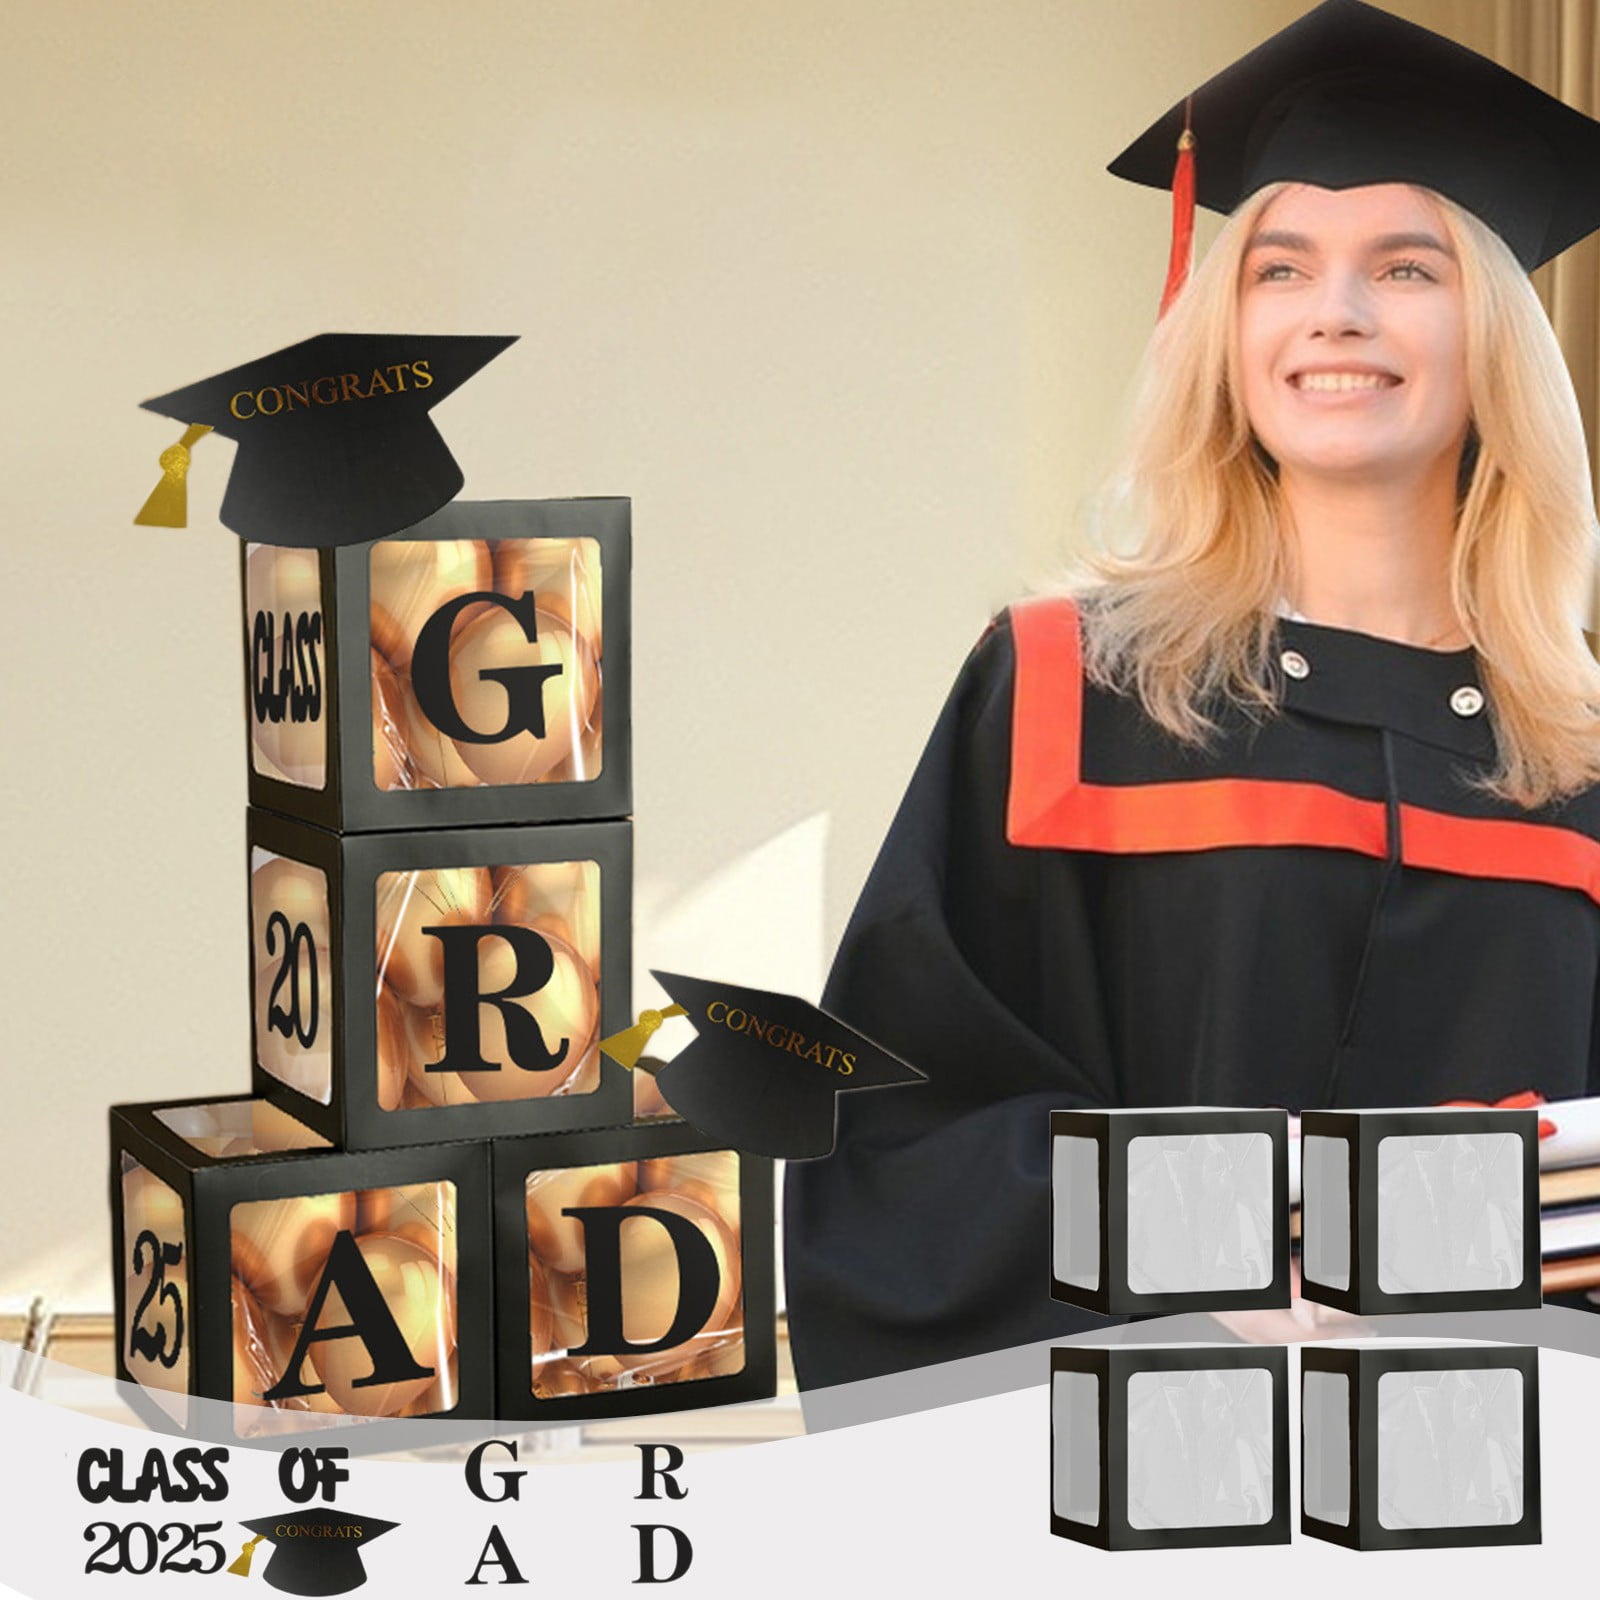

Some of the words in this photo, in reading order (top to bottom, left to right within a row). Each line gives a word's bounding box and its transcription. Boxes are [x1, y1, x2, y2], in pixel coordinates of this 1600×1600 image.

[229, 359, 435, 421] CONGRATS
[252, 608, 323, 724] CLASS
[411, 590, 563, 745] G
[266, 910, 319, 1049] 20
[421, 923, 570, 1074] R
[706, 1000, 857, 1077] CONGRATS
[130, 1230, 185, 1368] 25
[262, 1229, 435, 1402] A
[561, 1205, 721, 1357] D
